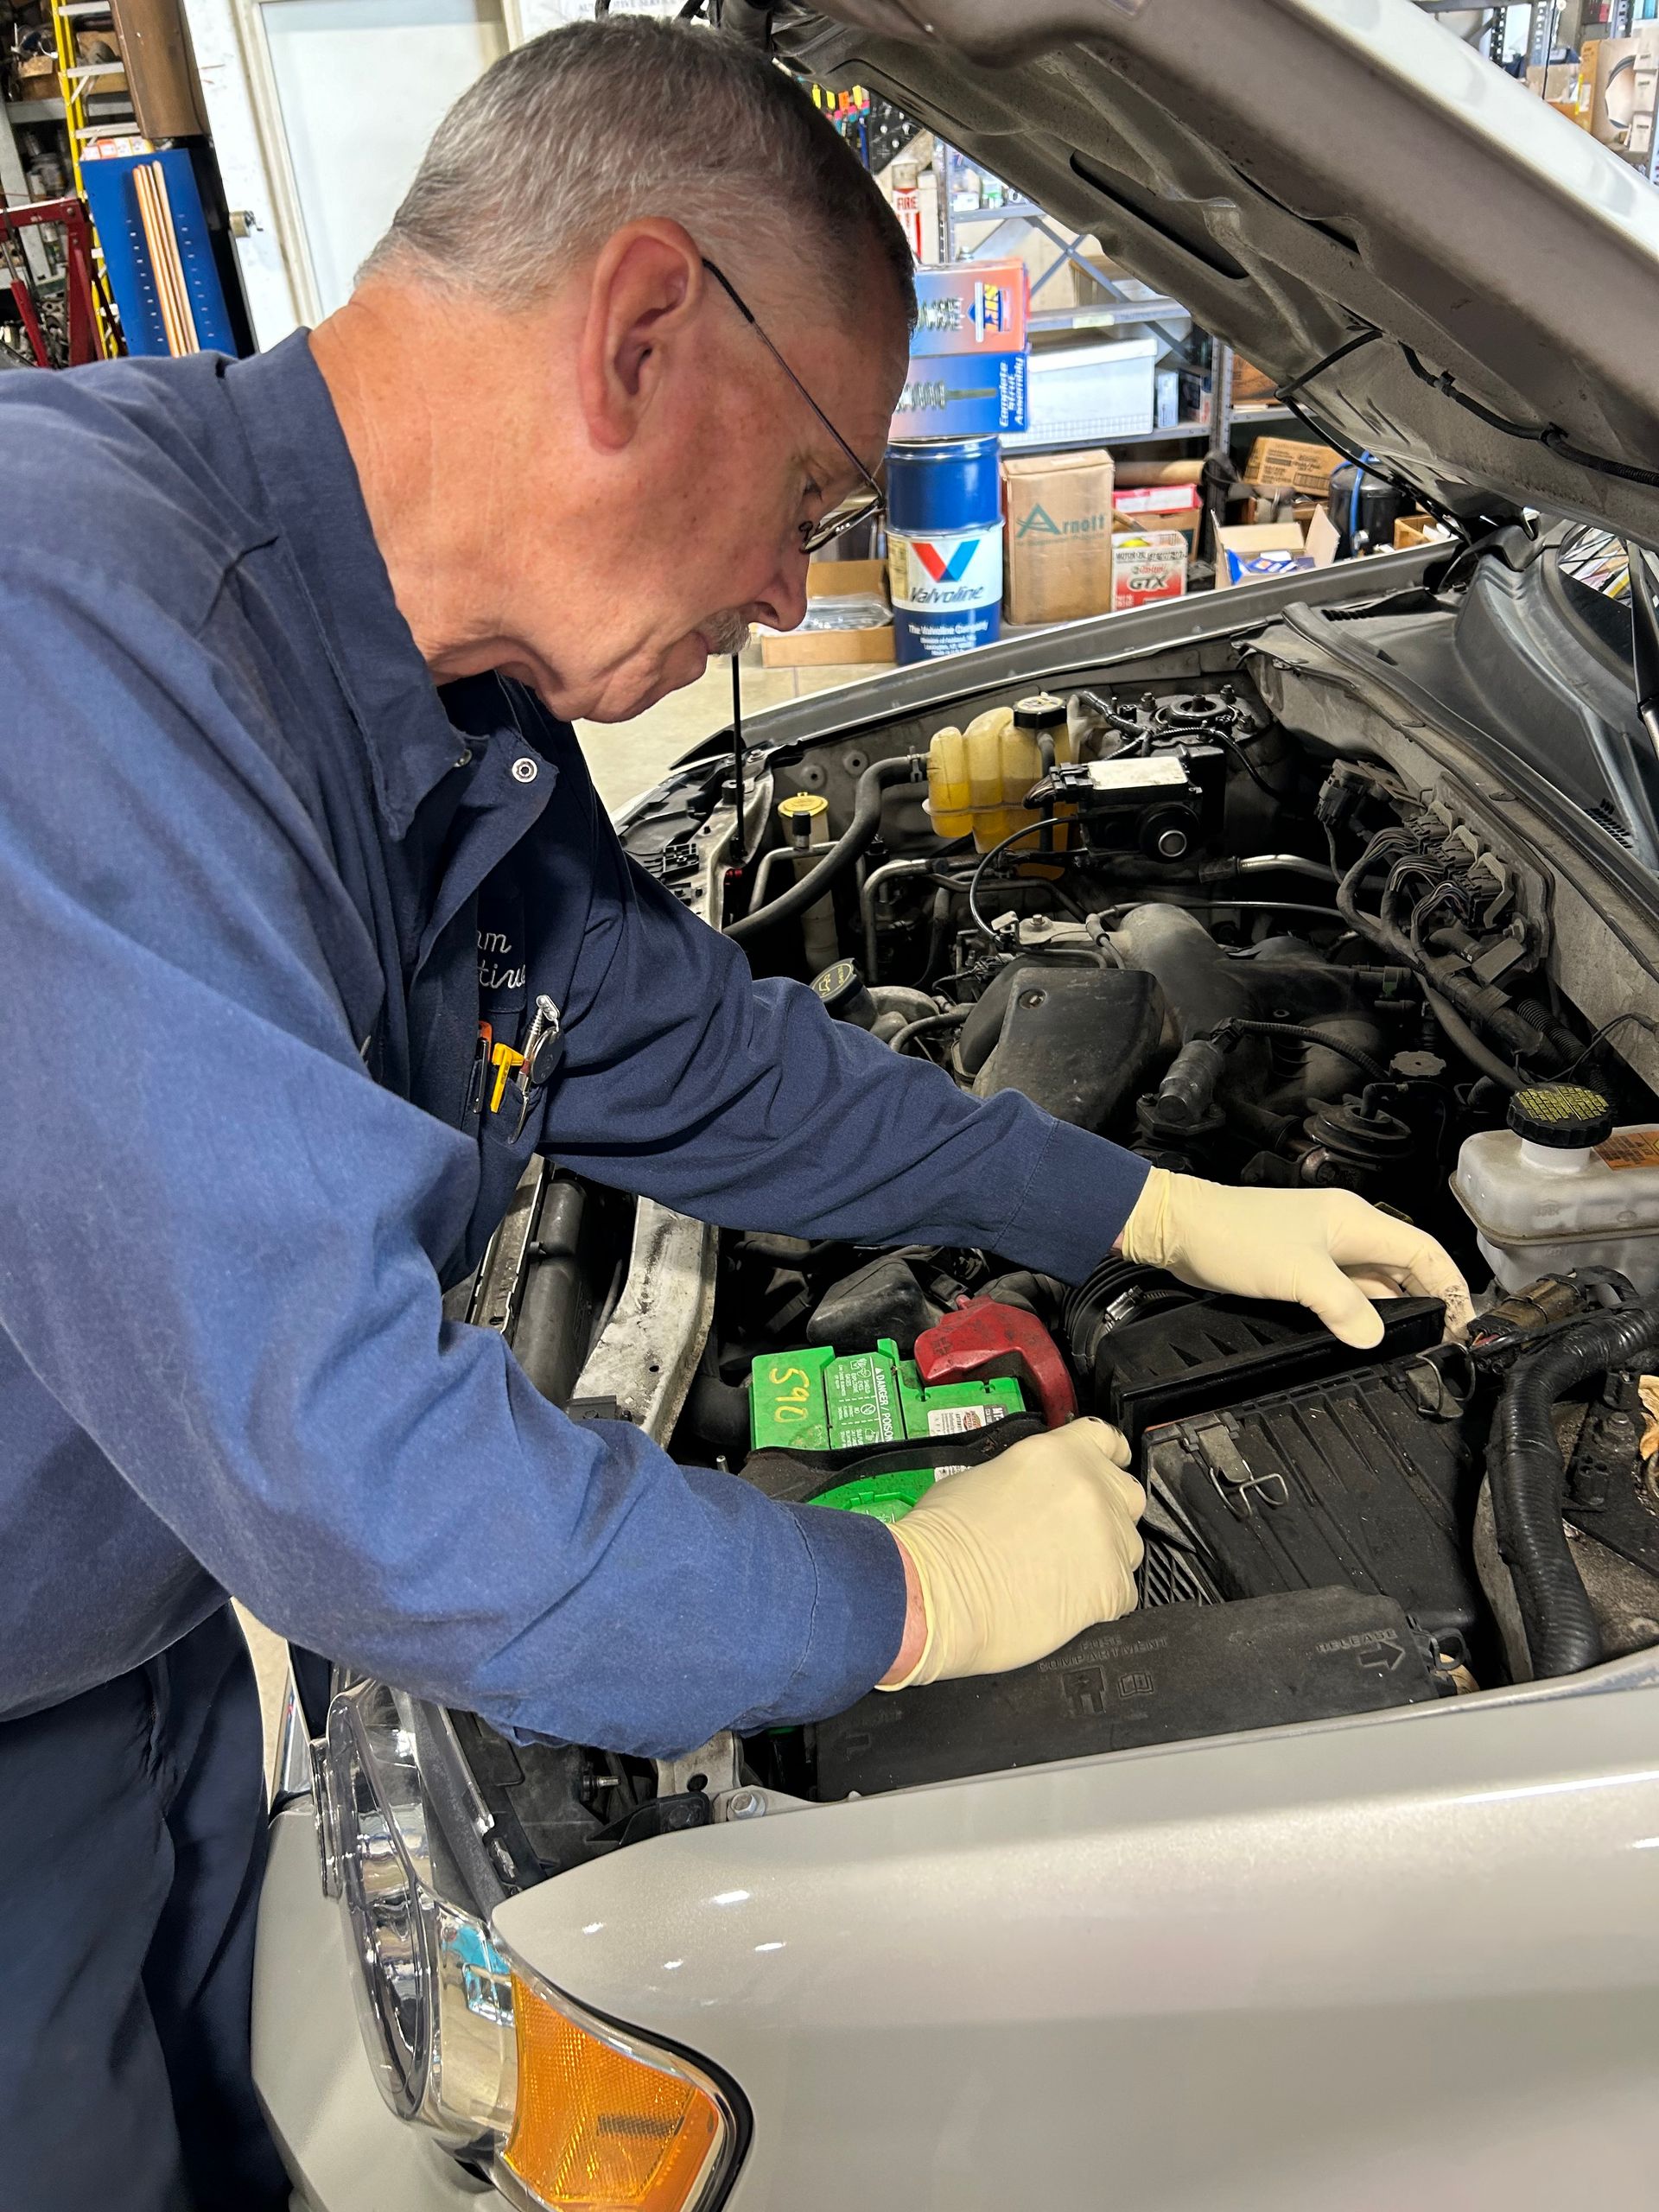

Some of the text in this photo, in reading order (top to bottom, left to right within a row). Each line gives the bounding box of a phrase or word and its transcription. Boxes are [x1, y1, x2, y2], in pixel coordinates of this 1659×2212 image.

[897, 196, 917, 210] FIRE
[1015, 502, 1105, 539] Arnott
[1129, 575, 1167, 589] GTX
[909, 586, 984, 604] Valvoline
[876, 1375, 889, 1407] DANGER
[1079, 1634, 1122, 1651] FUSE
[1315, 1628, 1399, 1654] RELEASE
[1037, 1637, 1168, 1674] COMPARTMENT
